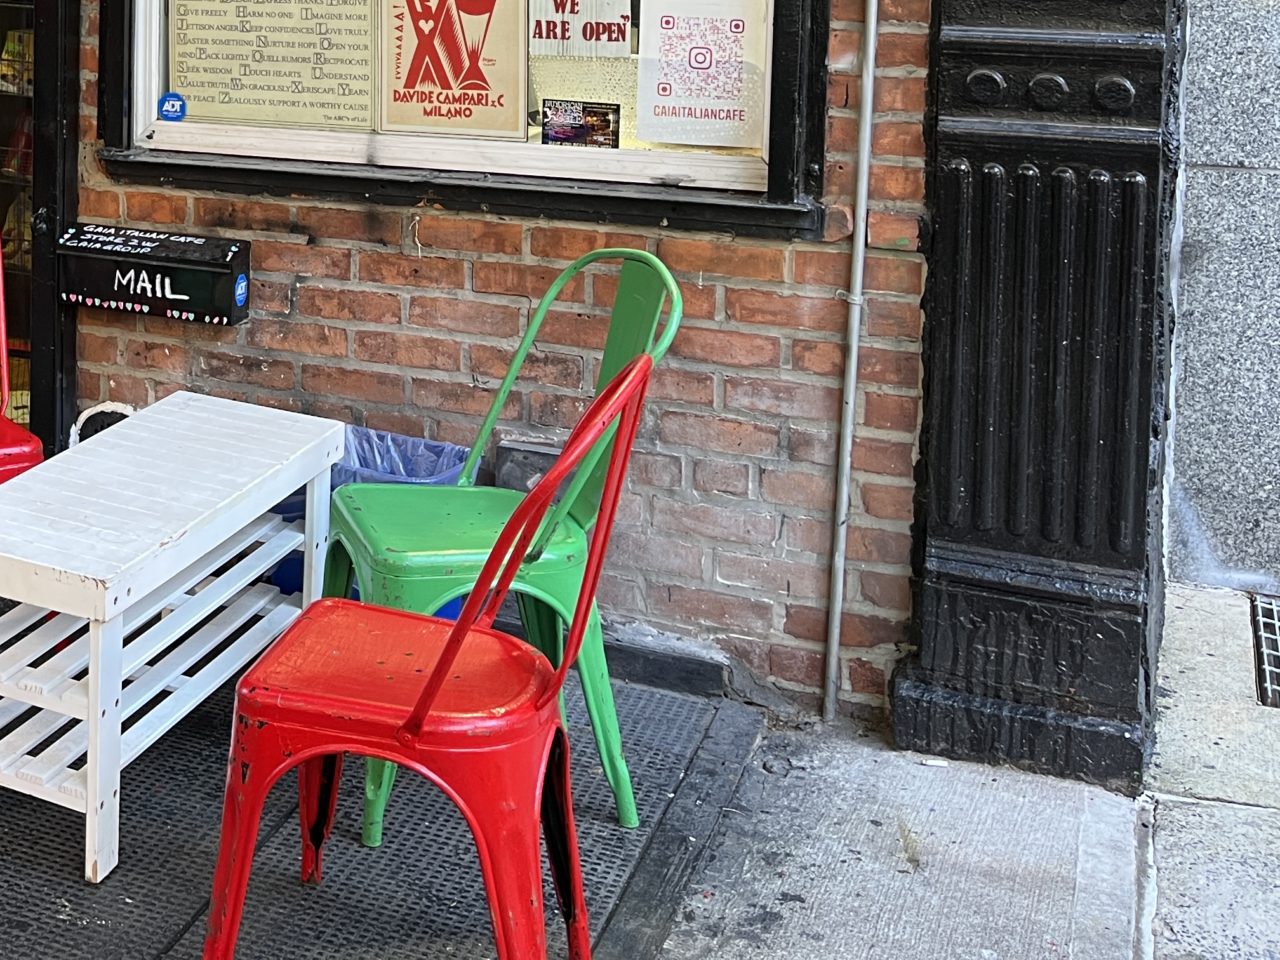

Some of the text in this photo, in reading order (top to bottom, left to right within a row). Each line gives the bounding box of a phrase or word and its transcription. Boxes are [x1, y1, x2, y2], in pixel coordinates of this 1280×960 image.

[177, 4, 199, 16] GIVE
[236, 6, 263, 18] HARM
[301, 8, 343, 20] IMAGINE
[177, 19, 214, 30] JETTISON
[239, 20, 263, 32] KEEP
[264, 26, 314, 34] CONFIDENCES
[316, 23, 343, 35] LOVE
[344, 28, 368, 36] TRULY
[532, 19, 571, 40] ARE
[177, 32, 209, 45] MASTER
[211, 38, 254, 46] SOMETHING
[256, 35, 296, 48] NURTURE
[298, 41, 317, 49] HOPE
[320, 37, 346, 50] OPEN
[196, 48, 221, 60] PACK
[222, 53, 249, 61] LIGHTLY
[252, 50, 281, 63] QUELL
[282, 55, 311, 63] RUMORS
[313, 52, 369, 66] RECIPROCATE
[177, 61, 200, 73] SEEK
[239, 64, 271, 76] TOUCH
[312, 67, 369, 81] UNDERSTAND
[177, 75, 369, 96] VALUE TRUTH WIN GRACIOUSLY XERISCAPE YEARN
[162, 101, 183, 112] ADT
[219, 91, 266, 105] ZEALOUSLY
[268, 100, 300, 108] SUPPORT
[309, 102, 341, 110] WORTHY
[343, 103, 369, 111] CAUSE
[393, 90, 434, 104] DAVIDE
[436, 92, 489, 107] CAMPARI
[423, 106, 473, 120] MILANO
[653, 104, 746, 121] GAIAITALIANCAFE
[80, 233, 124, 245] STORE
[127, 238, 139, 247] 2
[83, 224, 206, 245] GAIA ITALIAN CAFE
[66, 239, 152, 254] GAIA GROUP
[114, 268, 190, 301] MAIL
